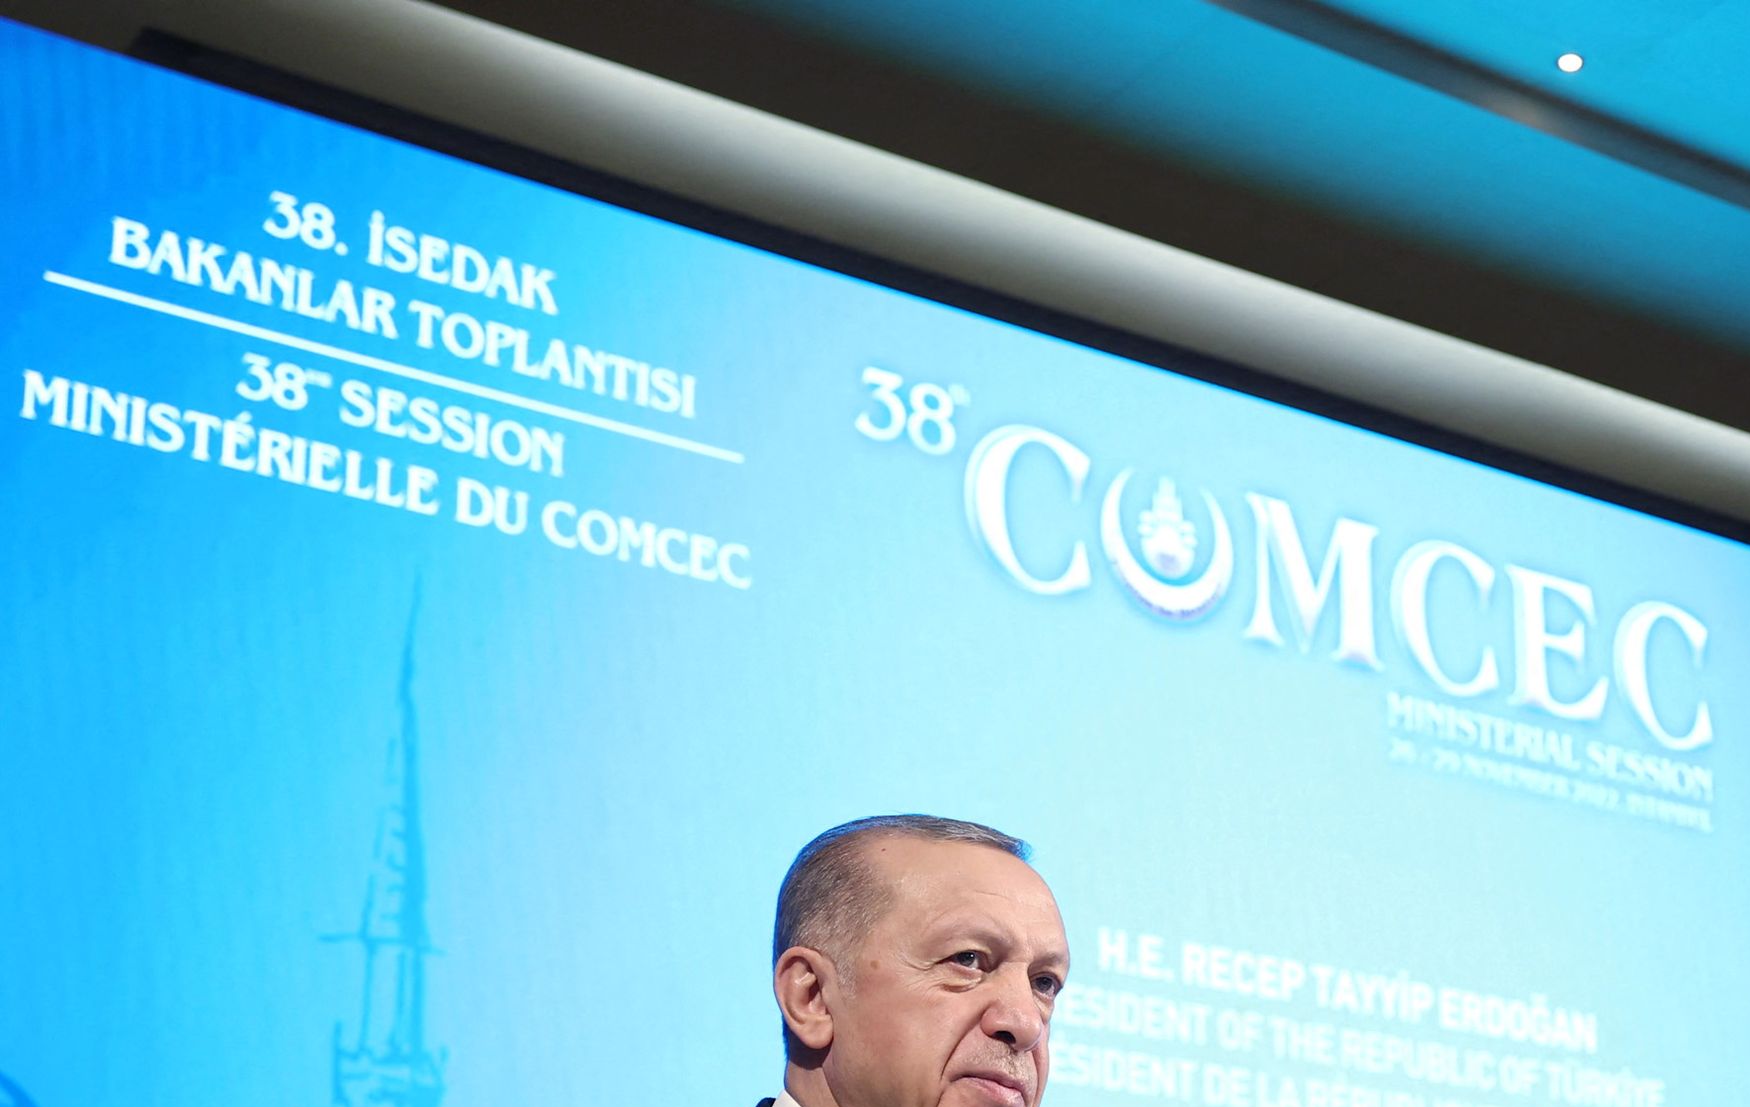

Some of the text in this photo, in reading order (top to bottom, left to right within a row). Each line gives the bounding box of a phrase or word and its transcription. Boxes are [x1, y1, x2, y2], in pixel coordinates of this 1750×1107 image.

[262, 191, 558, 315] 38. İSEDAK
[109, 216, 696, 418] BAKANLAR TOPLANTISI
[20, 369, 752, 590] MINISTÉRIELLE DU COMCEC
[339, 378, 565, 477] SESSION
[963, 423, 1714, 752] COMCEC
[1387, 691, 1713, 803] MINISTERIAL SESSION
[1098, 928, 1598, 1055] H.E. RECEP TAYYİP ERDOĞAN
[1216, 1008, 1264, 1050] OF
[1268, 1016, 1336, 1066] THE
[1341, 1028, 1496, 1091] REPUBLIC
[1500, 1054, 1539, 1097] OF
